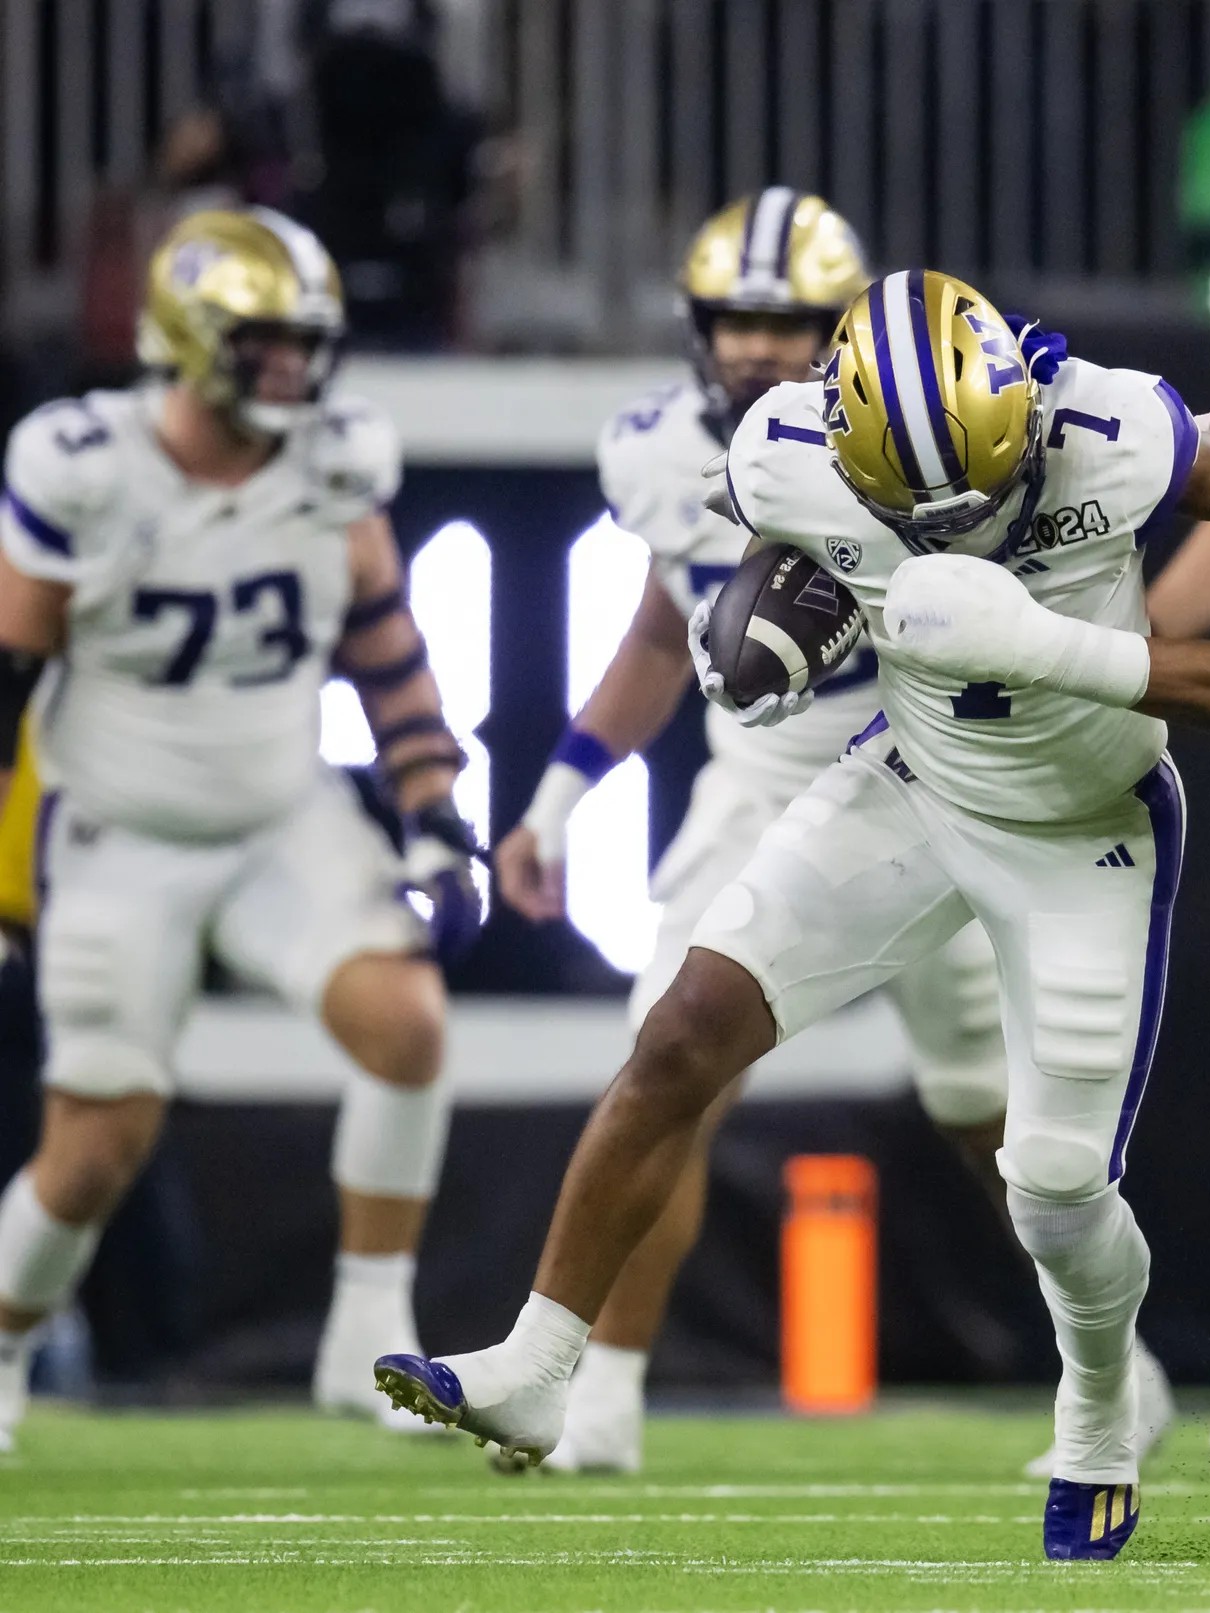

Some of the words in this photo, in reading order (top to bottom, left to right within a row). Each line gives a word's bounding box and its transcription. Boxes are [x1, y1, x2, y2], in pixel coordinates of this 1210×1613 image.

[966, 312, 1027, 396] W
[1047, 407, 1121, 450] 7
[828, 539, 861, 563] PAC
[836, 553, 854, 568] 12
[133, 571, 311, 689] 73
